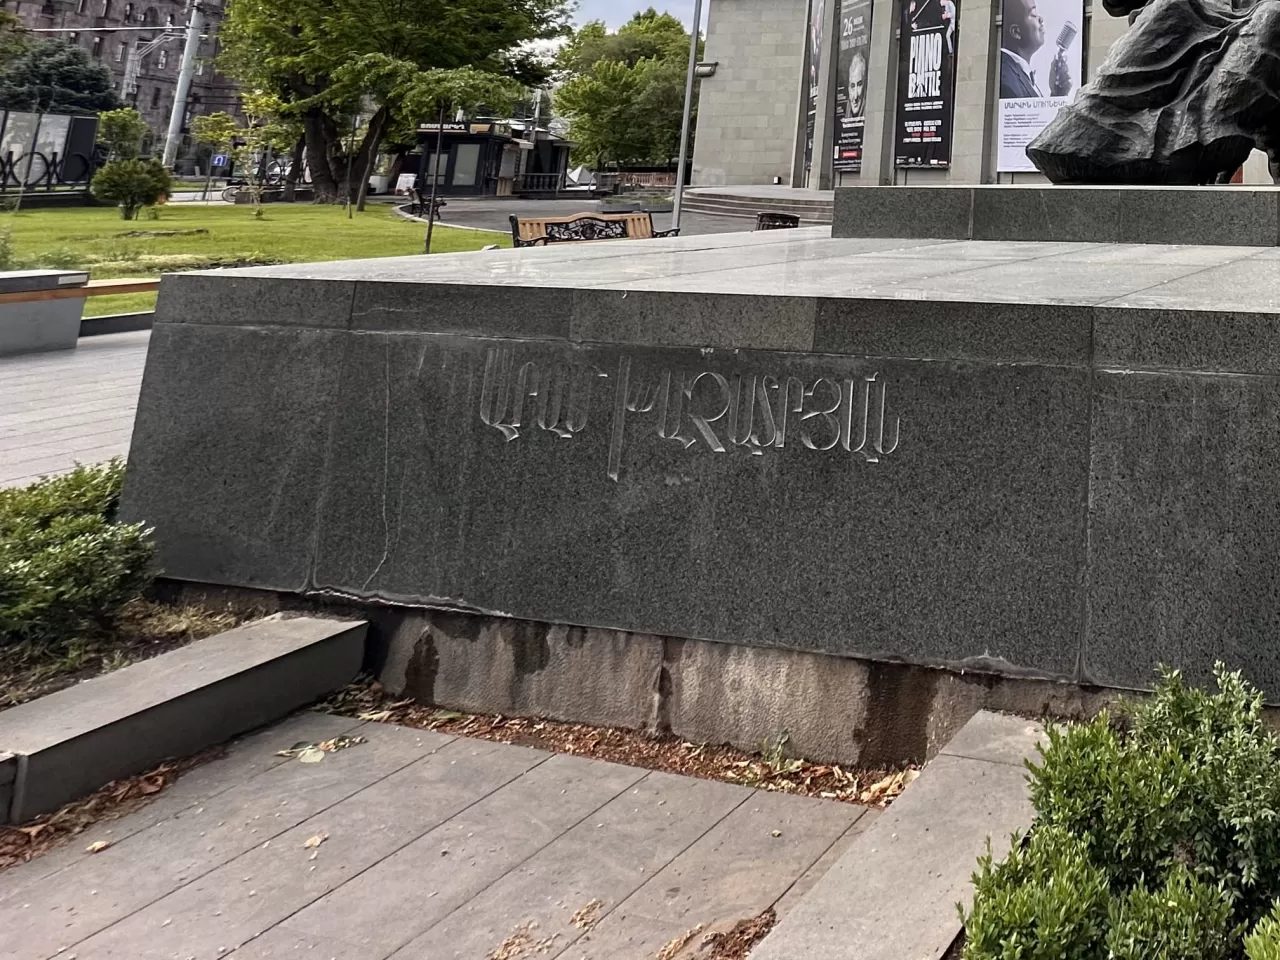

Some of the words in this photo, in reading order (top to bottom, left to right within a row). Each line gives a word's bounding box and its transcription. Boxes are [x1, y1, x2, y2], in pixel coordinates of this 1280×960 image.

[842, 16, 854, 36] 26
[909, 32, 942, 73] PIANO
[908, 70, 941, 98] BATTLE
[1004, 101, 1032, 109] ՄԱՐՎԻՆ
